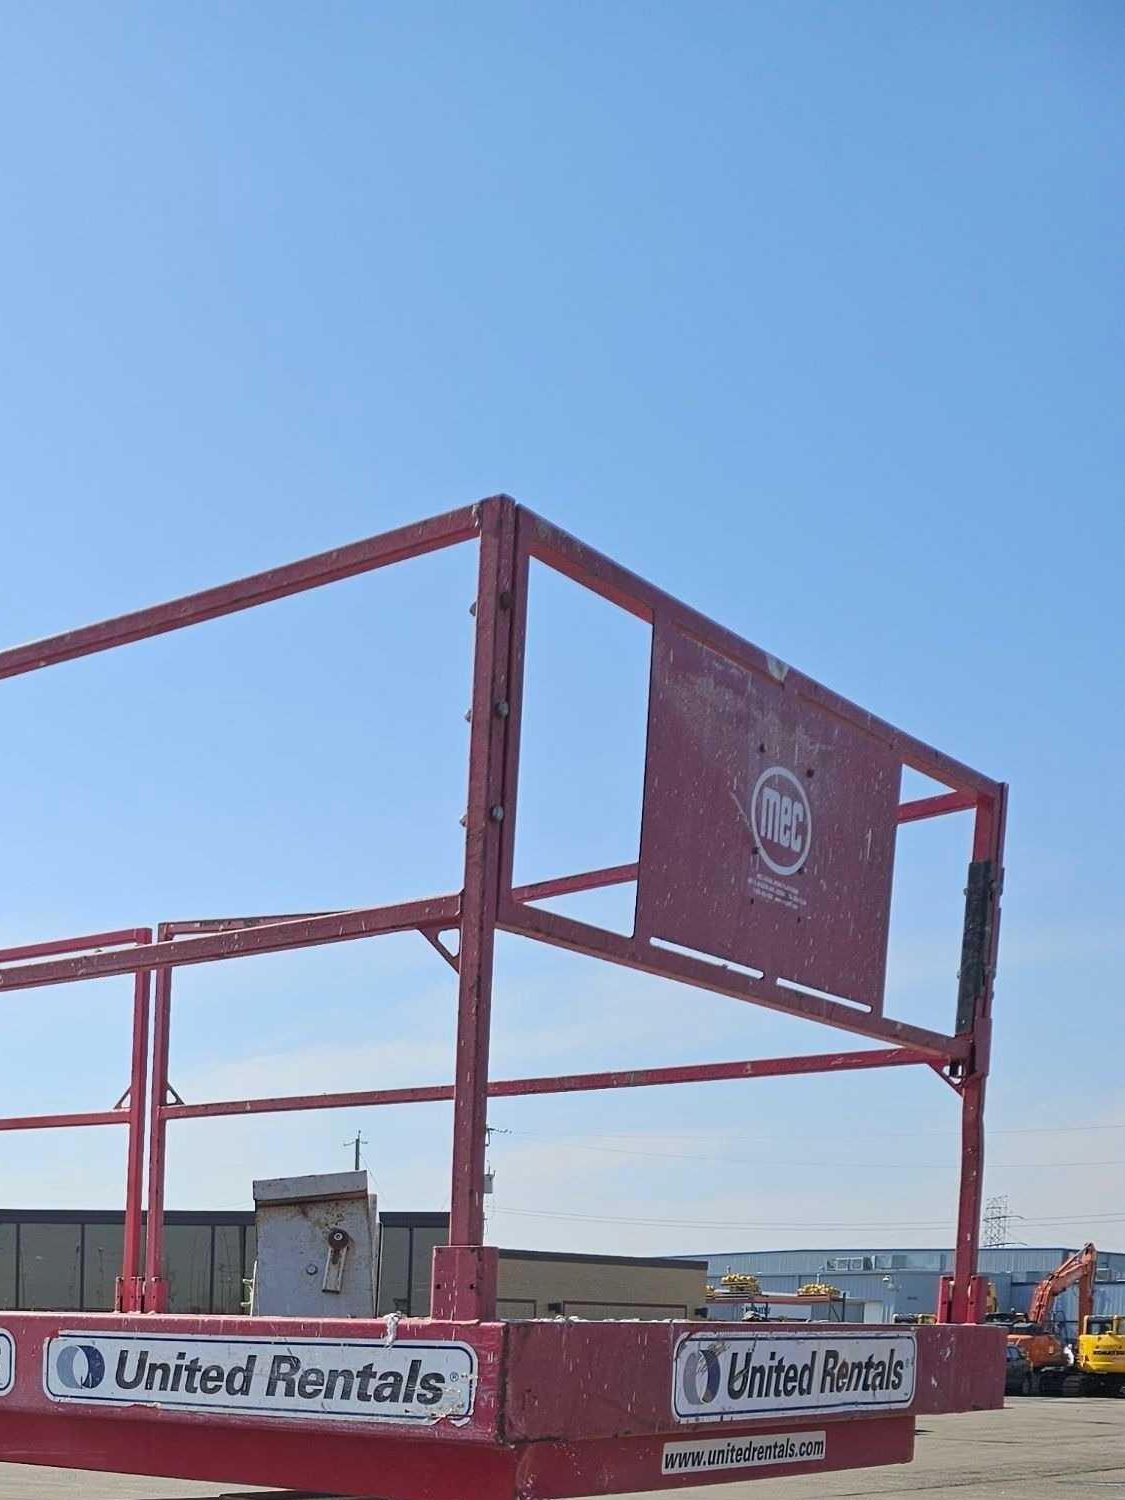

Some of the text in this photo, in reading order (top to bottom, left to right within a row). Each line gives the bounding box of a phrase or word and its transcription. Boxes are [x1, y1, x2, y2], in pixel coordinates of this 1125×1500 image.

[115, 1349, 446, 1405] United Rentals
[727, 1349, 905, 1402] United Rentals
[665, 1438, 825, 1470] www.unitedrentals.com
